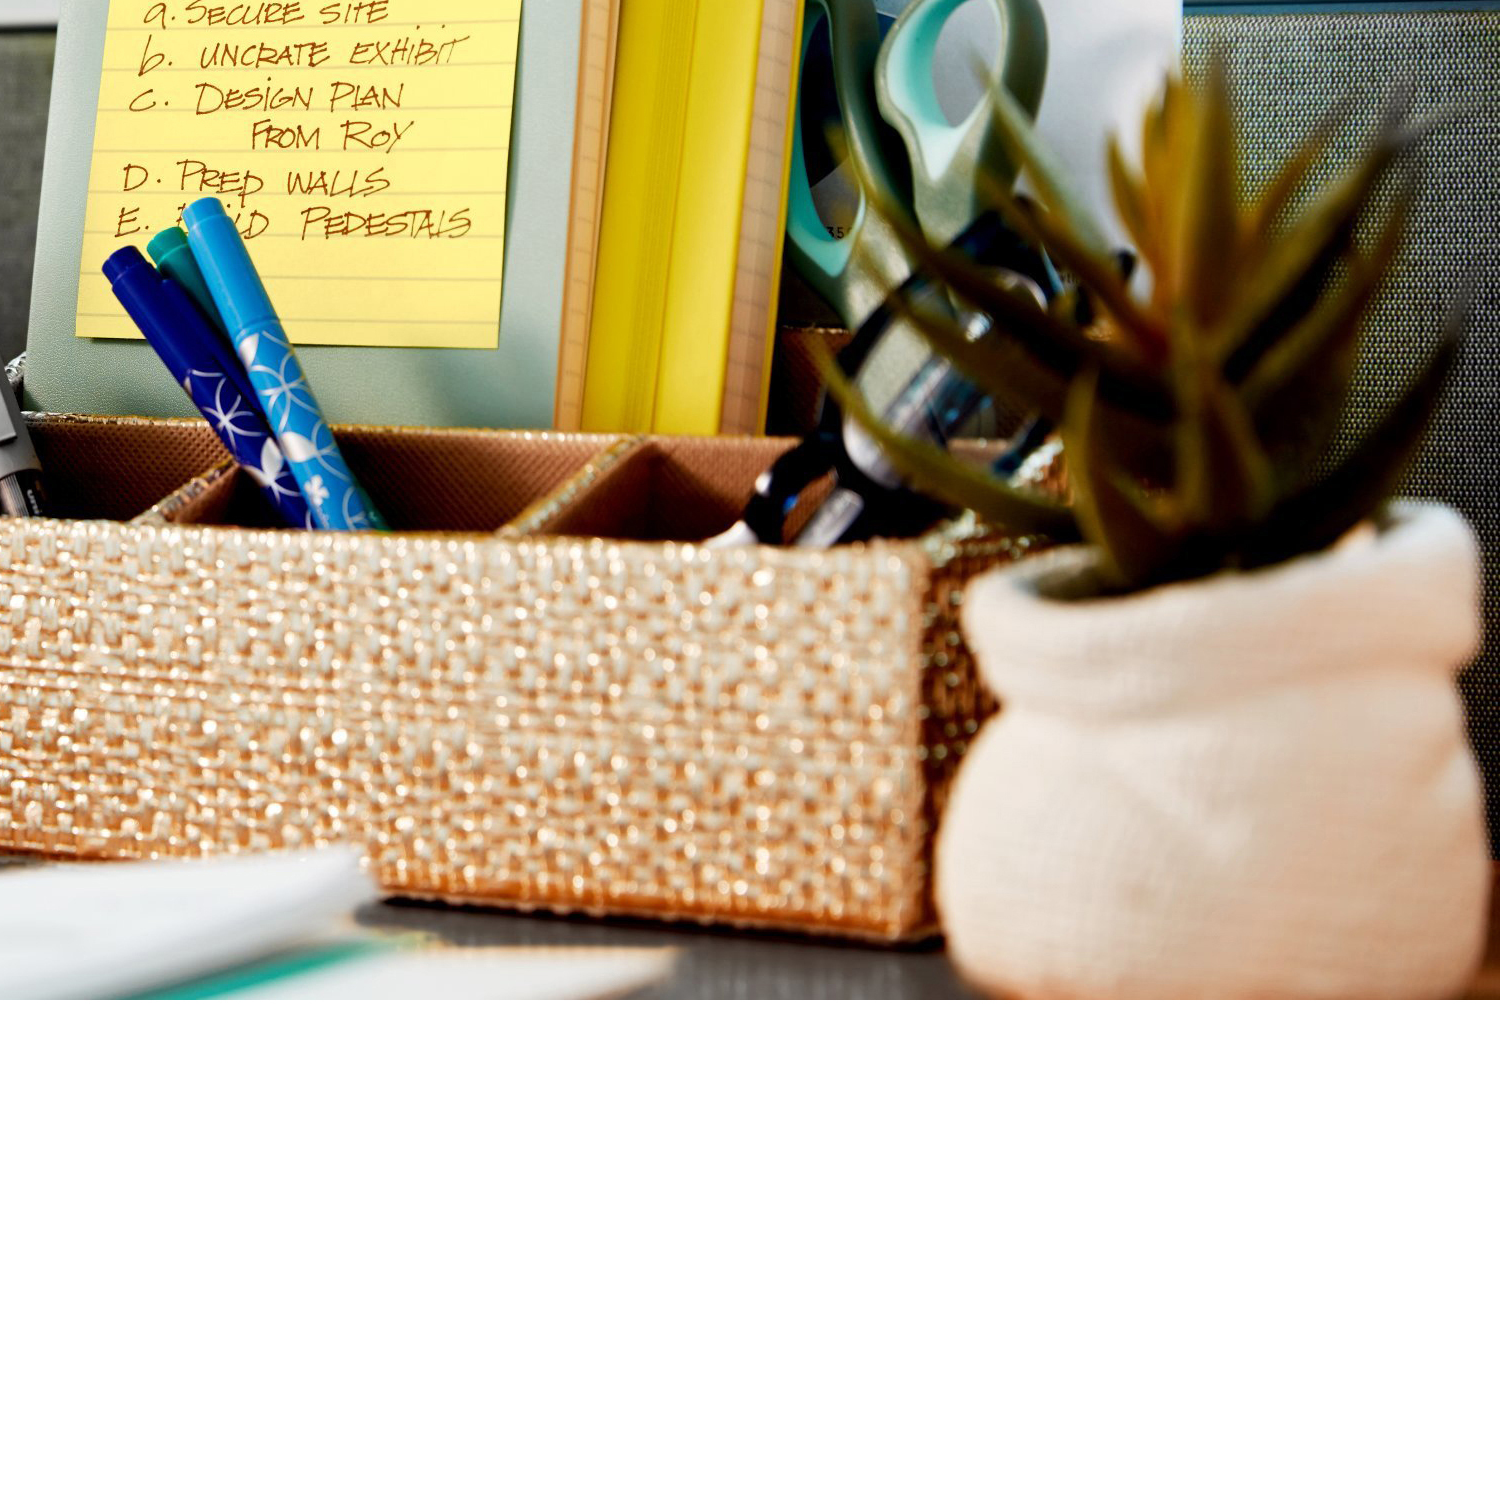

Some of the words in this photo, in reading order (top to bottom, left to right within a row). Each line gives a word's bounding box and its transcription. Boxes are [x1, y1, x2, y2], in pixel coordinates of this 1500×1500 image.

[199, 41, 331, 70] UNCRATE
[329, 80, 405, 113] PLAN
[251, 118, 321, 151] FROM
[175, 158, 265, 208] PREP
[286, 166, 391, 199] WALLS
[300, 205, 472, 241] PEDESTALS
